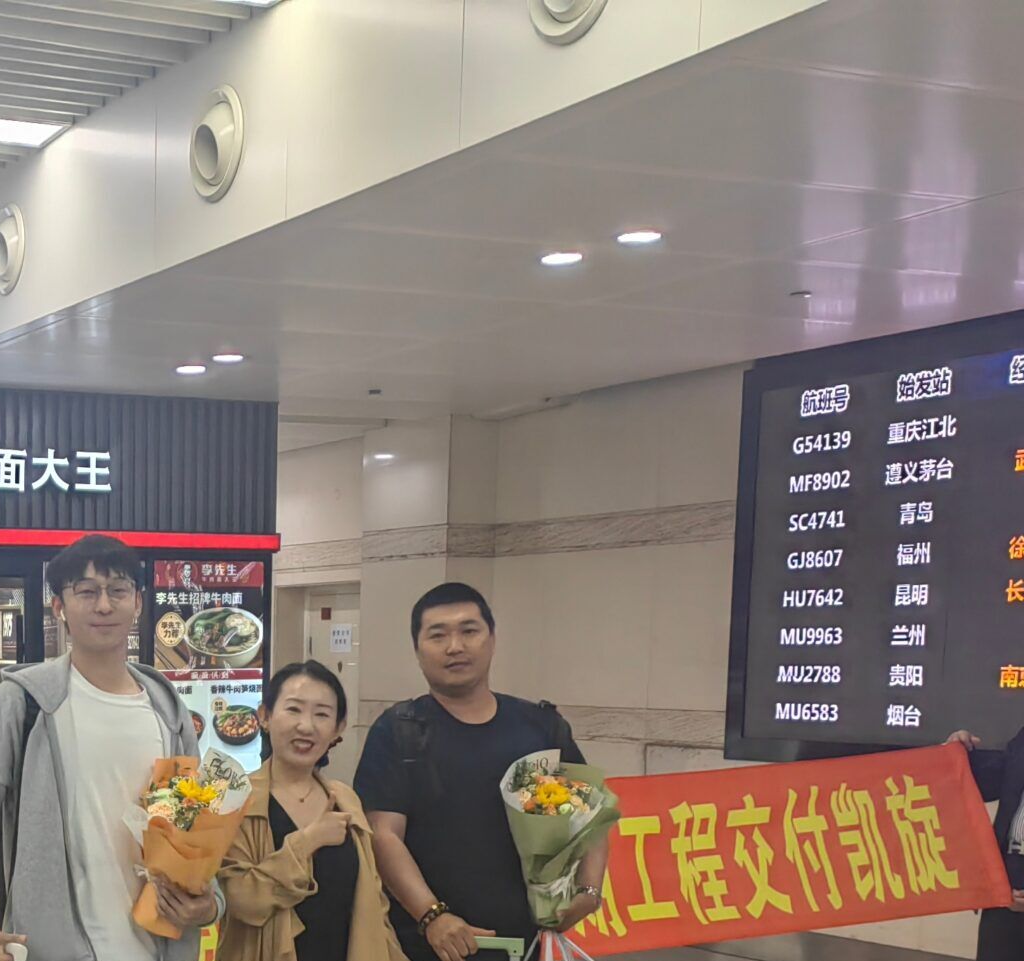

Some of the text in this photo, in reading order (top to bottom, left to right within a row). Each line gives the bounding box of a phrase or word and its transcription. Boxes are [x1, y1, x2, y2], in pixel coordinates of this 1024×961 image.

[800, 384, 850, 417] 航班号
[897, 367, 952, 402] 始发站
[792, 414, 957, 455] G54139 重庆江北
[789, 470, 851, 494] MF8902
[885, 457, 955, 486] 遵义茅台
[788, 501, 933, 532] SC4741 青岛
[201, 563, 237, 576] 李先生
[787, 549, 843, 570] GJ8607
[896, 541, 931, 566] 福州
[156, 592, 243, 605] 李先生招牌牛肉面
[782, 579, 1024, 608] HU7642 昆明 长
[779, 623, 926, 647] MU9963 兰州
[777, 665, 841, 684] MU2788
[889, 664, 923, 687] 贵阳
[775, 702, 922, 727] MU6583 烟台
